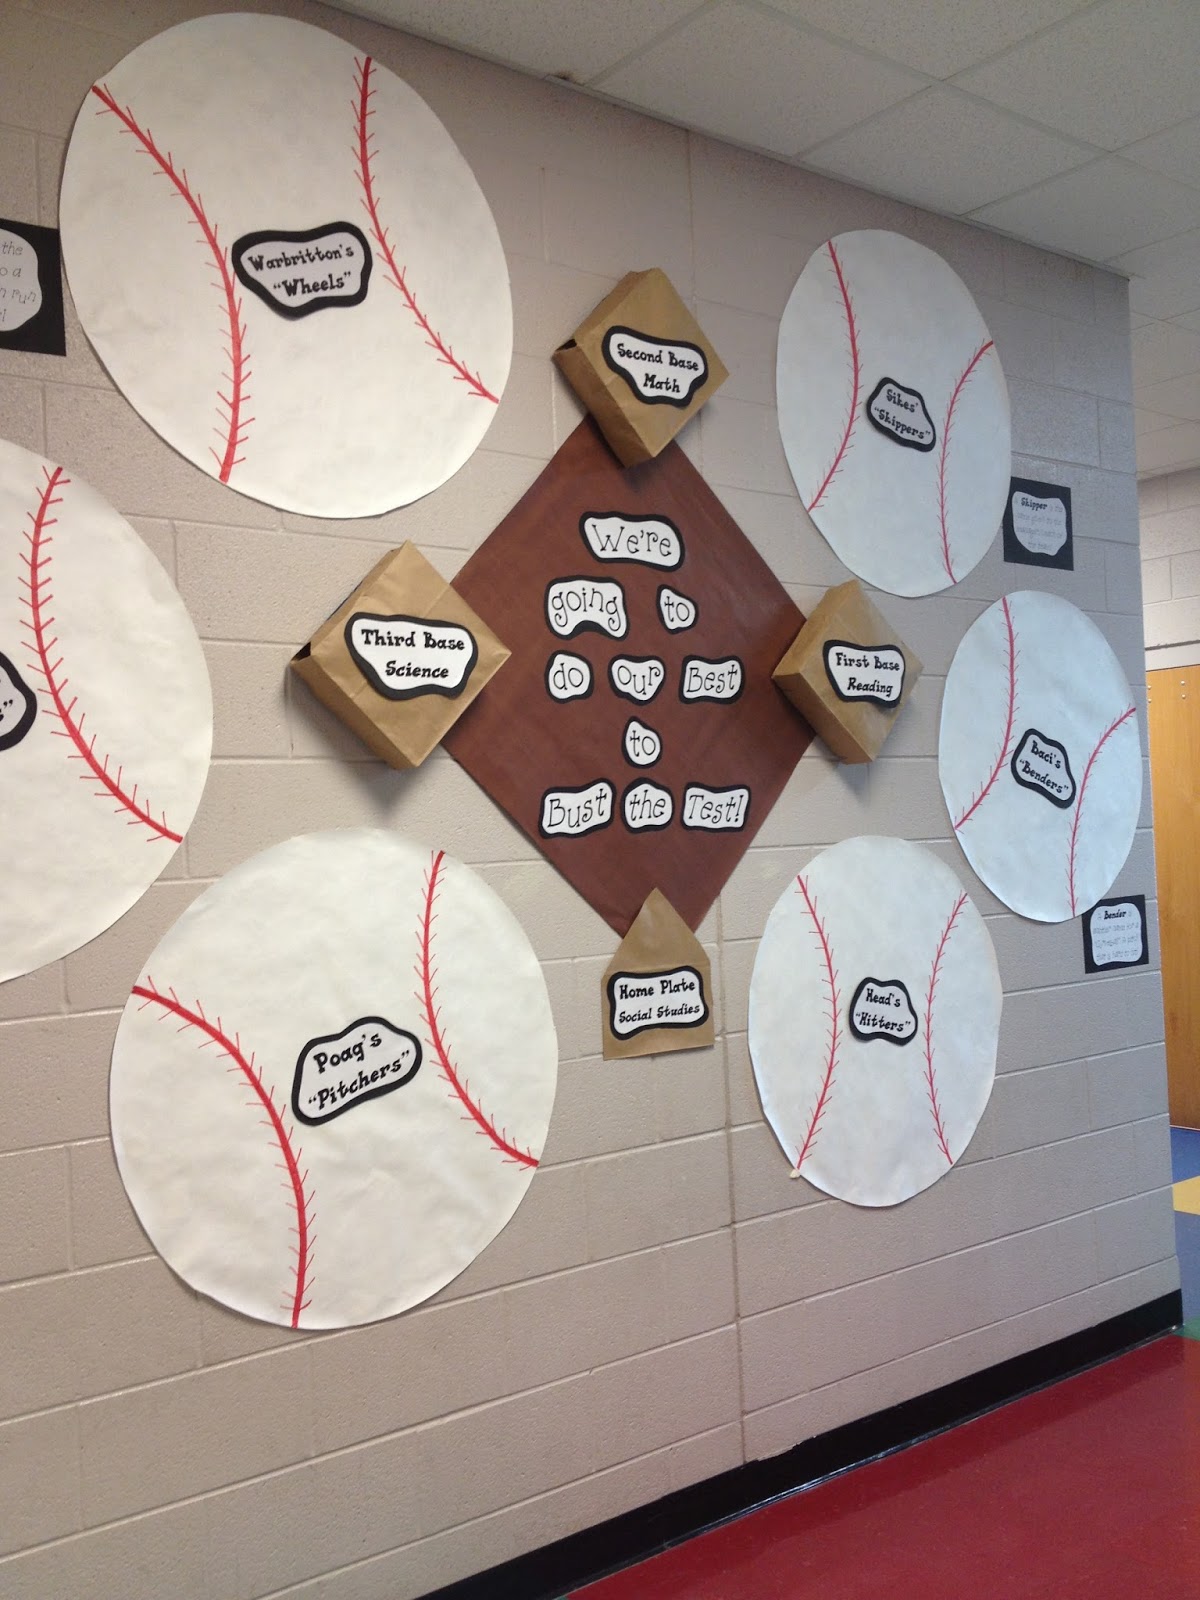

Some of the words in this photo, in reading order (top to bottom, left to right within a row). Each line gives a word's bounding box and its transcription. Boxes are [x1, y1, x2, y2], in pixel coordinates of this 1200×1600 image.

[2, 241, 23, 256] the
[247, 244, 354, 272] Warbritton's
[617, 343, 663, 364] Second
[668, 351, 699, 371] Base
[643, 373, 680, 393] Math
[886, 388, 918, 413] Sikes'
[1020, 497, 1048, 511] Skipper
[592, 524, 672, 557] We're
[551, 587, 618, 632] going
[664, 595, 690, 622] to
[361, 628, 416, 647] Third
[423, 631, 465, 651] Base
[385, 660, 450, 678] Science
[835, 651, 870, 668] First
[874, 655, 900, 671] Base
[553, 662, 584, 690] do
[686, 664, 738, 693] Best
[847, 677, 893, 698] Reading
[629, 730, 656, 757] to
[1031, 740, 1061, 769] Baci's
[547, 788, 607, 828] Bust
[629, 789, 666, 821] the
[688, 794, 744, 824] Test!
[1103, 909, 1127, 920] Bender
[619, 984, 655, 1000] Home
[660, 978, 695, 995] Plate
[865, 987, 901, 1008] Head's
[618, 1007, 653, 1024] Social
[656, 1003, 700, 1018] Studies
[313, 1033, 382, 1074] Poag's
